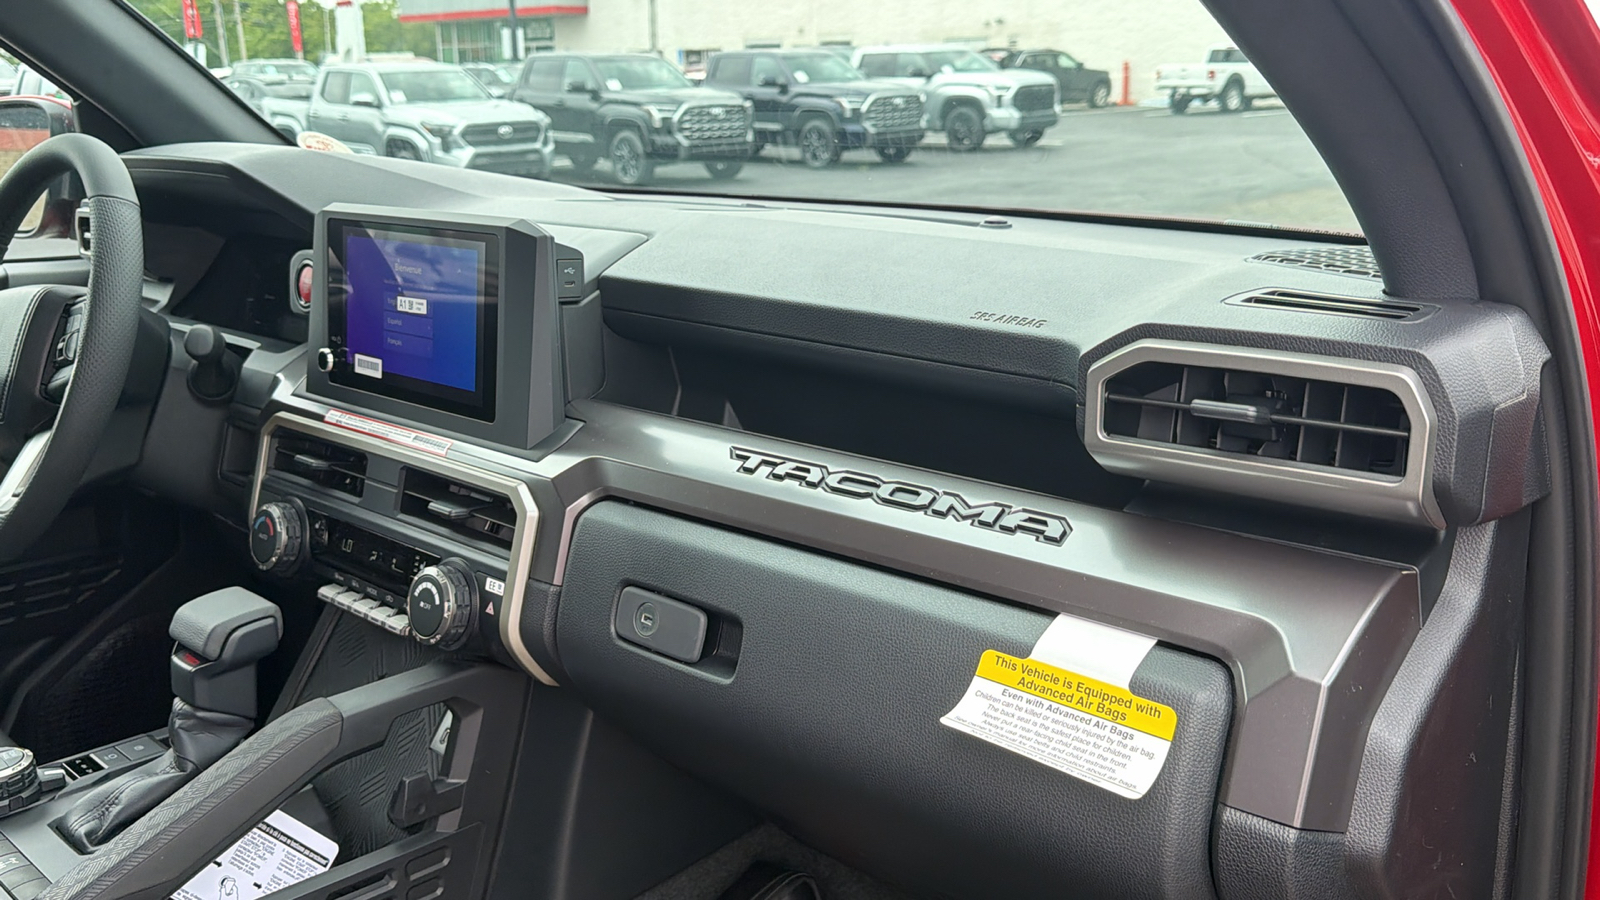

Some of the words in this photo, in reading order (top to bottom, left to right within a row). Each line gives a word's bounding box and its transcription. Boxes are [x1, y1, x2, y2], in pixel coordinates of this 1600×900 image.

[970, 311, 996, 321] SRS
[993, 314, 1047, 329] AIRBAG
[729, 446, 1073, 547] TACOMA
[488, 580, 496, 590] EE
[996, 654, 1017, 672] This
[1021, 663, 1060, 685] Vehicle
[1062, 677, 1073, 689] is
[1076, 682, 1132, 709] Equipped
[1136, 702, 1161, 718] with
[1002, 688, 1023, 702] Even
[1026, 698, 1044, 709] with
[1046, 704, 1092, 725] Advanced
[1093, 720, 1108, 731] Air
[1110, 726, 1134, 740] Bags
[1017, 676, 1074, 703] Advanced
[1076, 696, 1094, 710] Air
[1096, 702, 1127, 721] Bags
[975, 690, 1001, 704] Children
[1002, 700, 1014, 708] can
[1014, 704, 1024, 712] be
[1024, 707, 1041, 718] killed
[1051, 717, 1080, 732] seriously
[1082, 726, 1106, 742] injured
[1106, 736, 1116, 746] by
[1116, 740, 1128, 750] the
[1129, 744, 1140, 753] air
[1140, 748, 1156, 760] bag.
[982, 711, 1000, 721] Never
[1000, 718, 1012, 728] put
[1019, 724, 1054, 742] rear-facing
[1055, 738, 1072, 748] child
[1072, 745, 1088, 755] seat
[1096, 752, 1109, 762] the
[1109, 758, 1127, 770] front.
[982, 719, 1004, 731] Always
[1018, 732, 1033, 742] seat
[1034, 738, 1050, 749] belts
[1051, 746, 1065, 754] and
[1065, 751, 1082, 761] child
[1083, 758, 1116, 774] restraints.
[987, 704, 999, 712] The
[1000, 708, 1014, 718] back
[1016, 714, 1031, 724] seat
[1039, 721, 1050, 732] the
[1052, 727, 1072, 738] safest
[1072, 733, 1091, 746] place
[1092, 741, 1102, 750] for
[1102, 745, 1132, 761] children.
